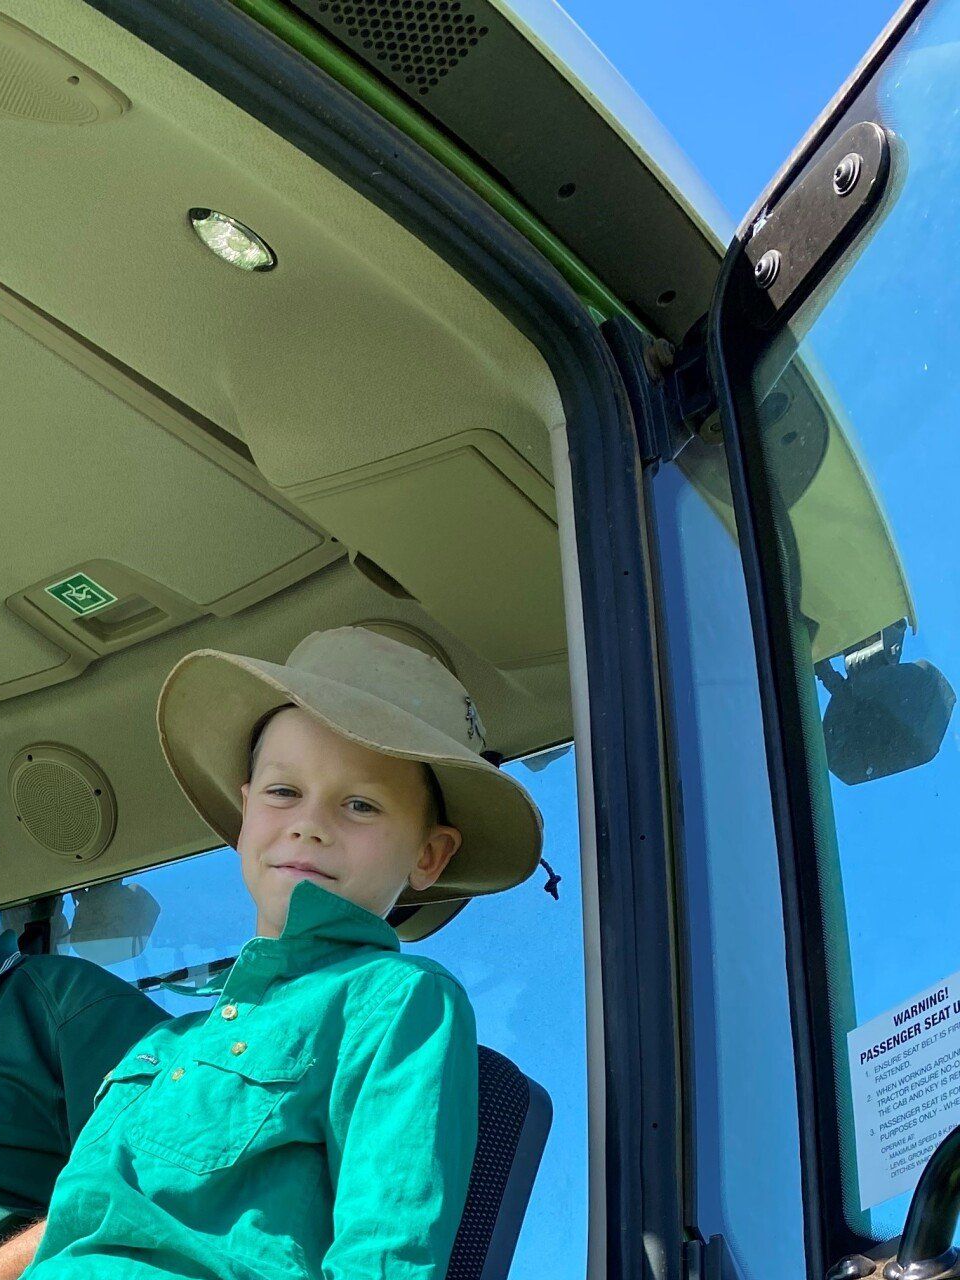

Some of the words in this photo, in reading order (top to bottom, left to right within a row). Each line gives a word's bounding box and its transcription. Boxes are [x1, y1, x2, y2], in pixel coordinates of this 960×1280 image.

[893, 987, 949, 1027] WARNING!
[860, 1022, 922, 1065] PASSENGER
[924, 1005, 951, 1030] SEAT
[874, 1054, 902, 1074] ENSURE
[902, 1044, 920, 1058] SEAT
[921, 1034, 938, 1048] BELT
[939, 1030, 946, 1038] IS
[876, 1080, 897, 1097] WHEN
[898, 1064, 932, 1087] WORKING
[933, 1048, 960, 1068] AROUN
[877, 1086, 910, 1108] TRACTOR
[910, 1072, 940, 1090] ENSURE
[878, 1106, 891, 1118] THE
[892, 1099, 908, 1110] CAB
[908, 1090, 924, 1102] AND
[925, 1082, 939, 1095] KEY
[940, 1077, 948, 1087] IS
[879, 1106, 921, 1132] PASSENGER
[922, 1096, 940, 1109] SEAT
[940, 1092, 948, 1101] IS
[949, 1085, 960, 1097] FO
[880, 1119, 918, 1142] PURPOSES
[919, 1108, 938, 1123] ONLY
[880, 1138, 906, 1154] OPERATE
[889, 1142, 917, 1159] MAXIMUM
[918, 1132, 938, 1146] SPEED
[890, 1159, 906, 1170] LEVEL
[908, 1146, 933, 1161] GROUND
[890, 1164, 916, 1178] DITCHES
